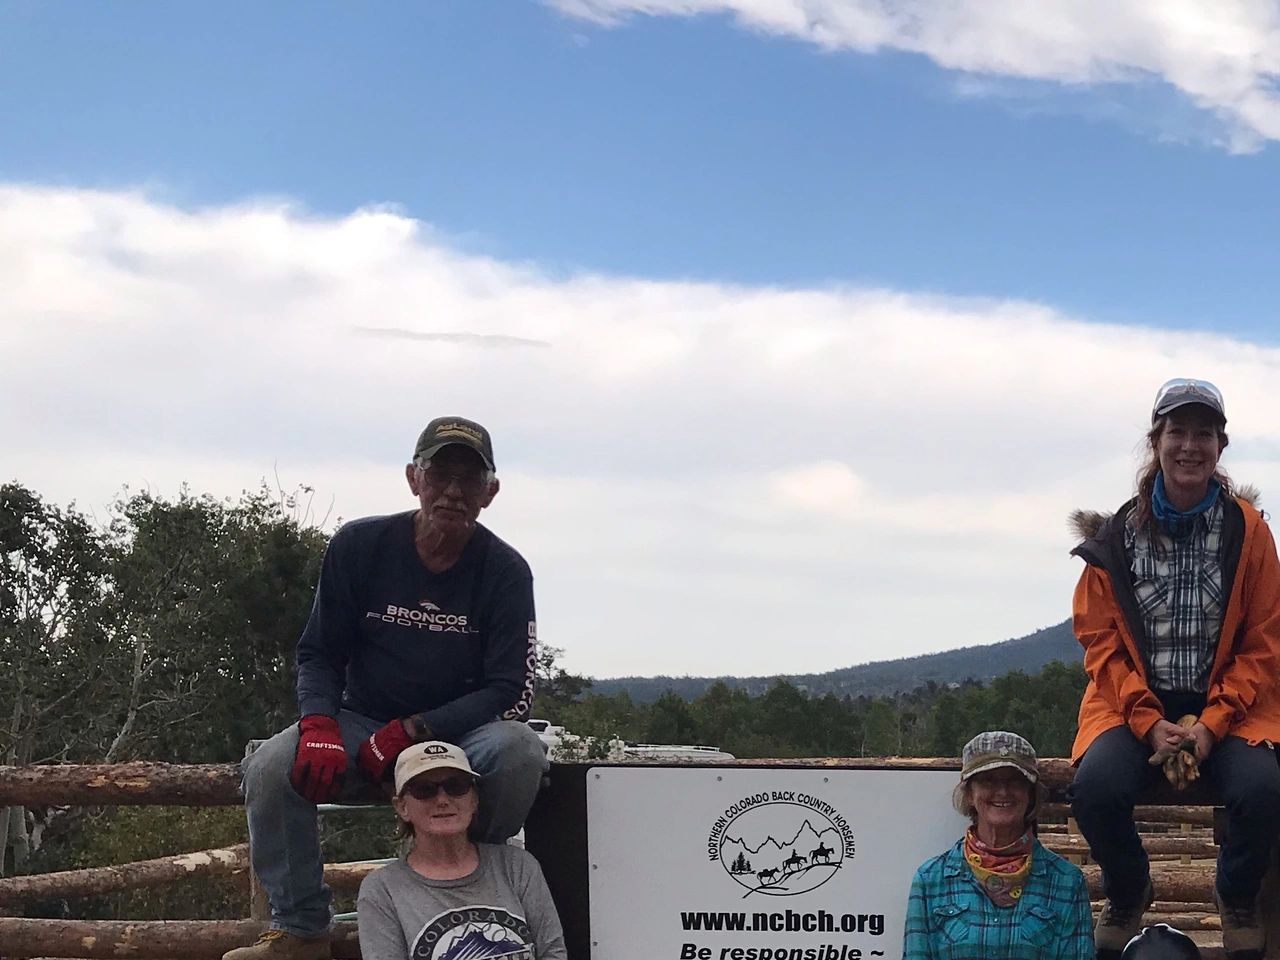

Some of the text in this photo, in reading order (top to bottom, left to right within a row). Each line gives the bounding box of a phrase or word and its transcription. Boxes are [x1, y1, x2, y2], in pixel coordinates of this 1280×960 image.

[366, 611, 480, 634] FOOTBALL
[387, 604, 468, 626] BRONCOS
[708, 791, 855, 861] NORTHERN COLORADO BACK COUNTRY HORSEMEN
[417, 911, 529, 957] COLORADO
[680, 909, 885, 936] www.ncbch.org
[680, 943, 712, 960] Be
